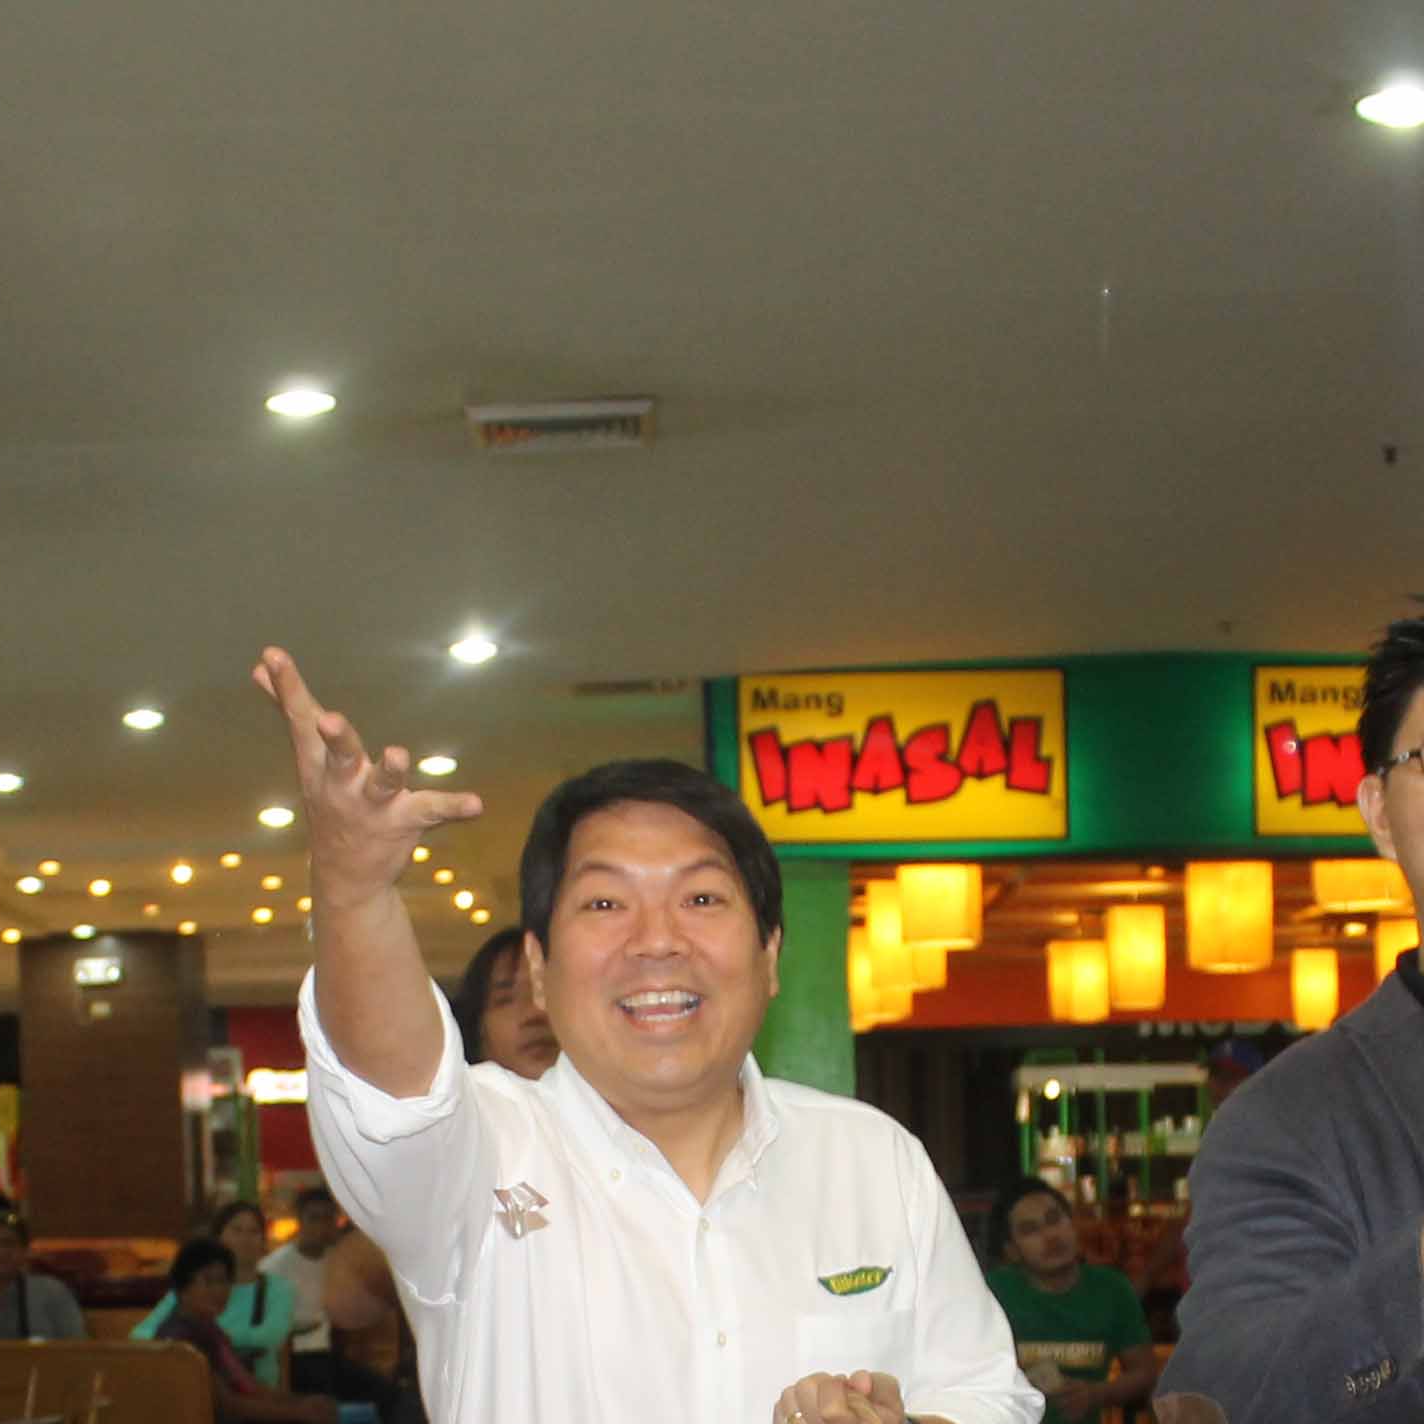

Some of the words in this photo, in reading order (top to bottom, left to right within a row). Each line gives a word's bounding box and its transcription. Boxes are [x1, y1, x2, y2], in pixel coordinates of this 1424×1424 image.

[750, 688, 844, 717] Mang
[1269, 680, 1364, 709] Mang
[747, 698, 1053, 815] INASAL
